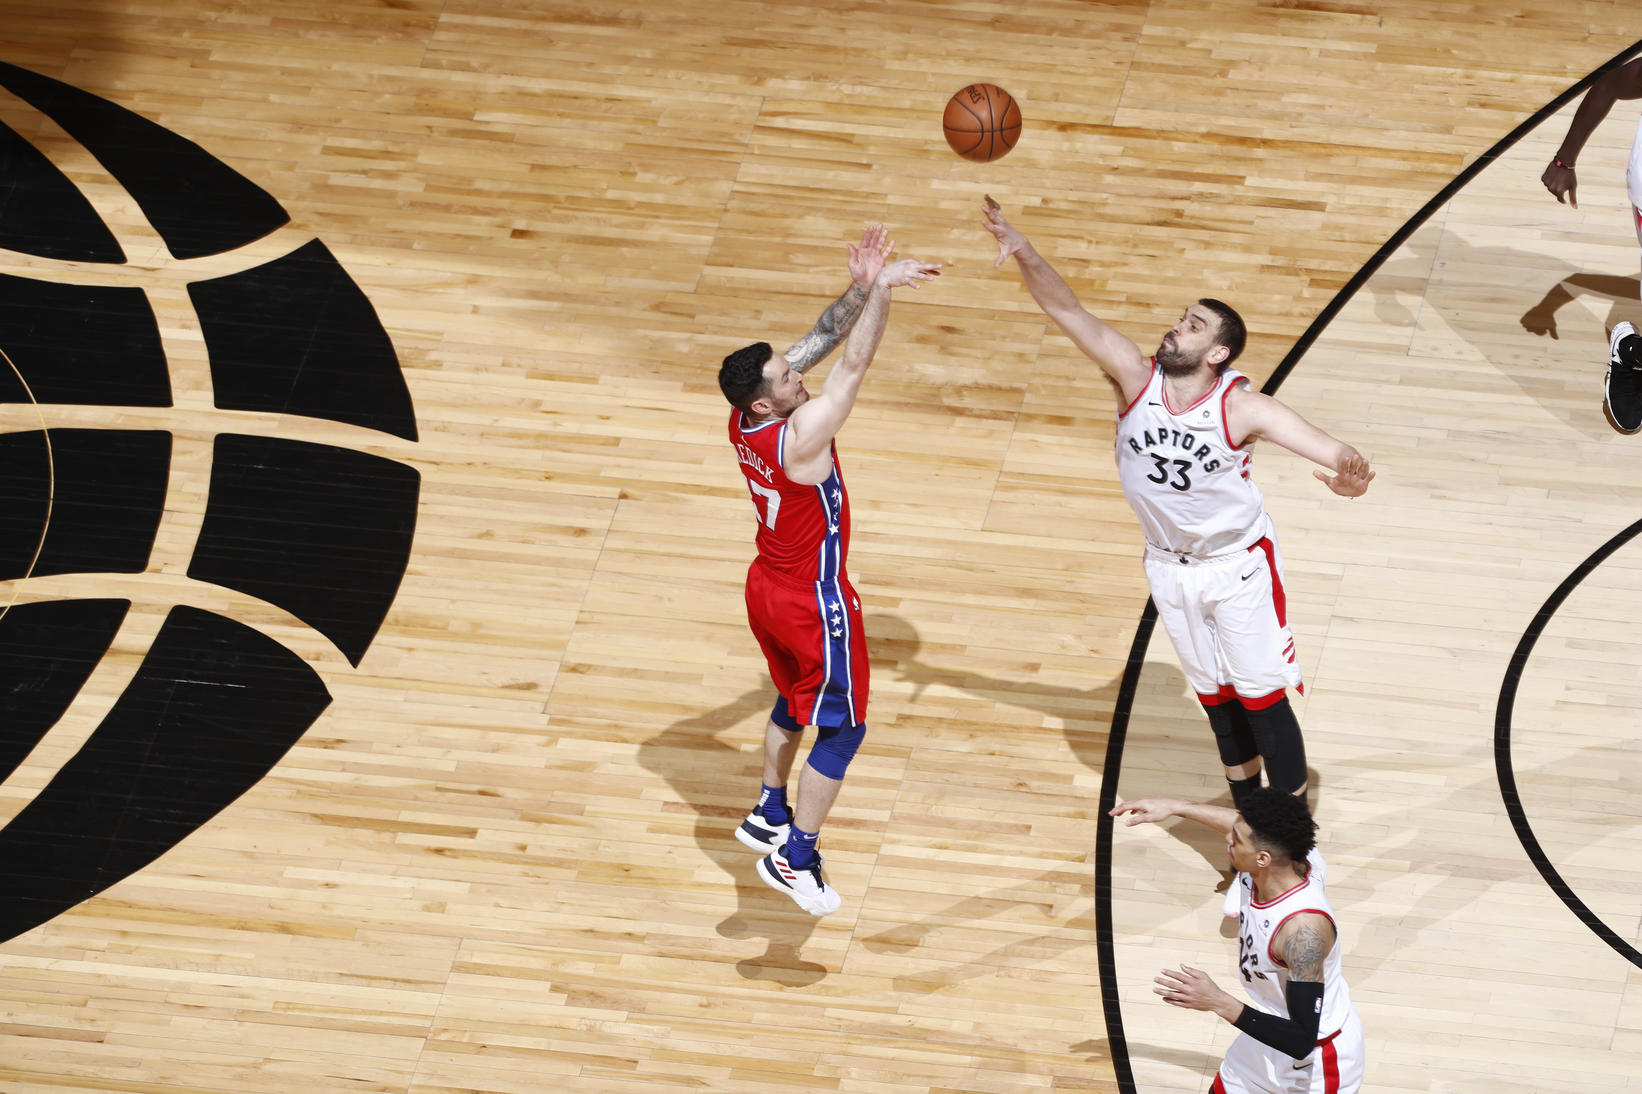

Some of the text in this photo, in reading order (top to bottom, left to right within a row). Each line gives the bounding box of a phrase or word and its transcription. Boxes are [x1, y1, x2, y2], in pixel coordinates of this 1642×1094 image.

[1128, 428, 1221, 473] RAPTORS
[1147, 452, 1192, 491] 33
[744, 474, 781, 532] 7
